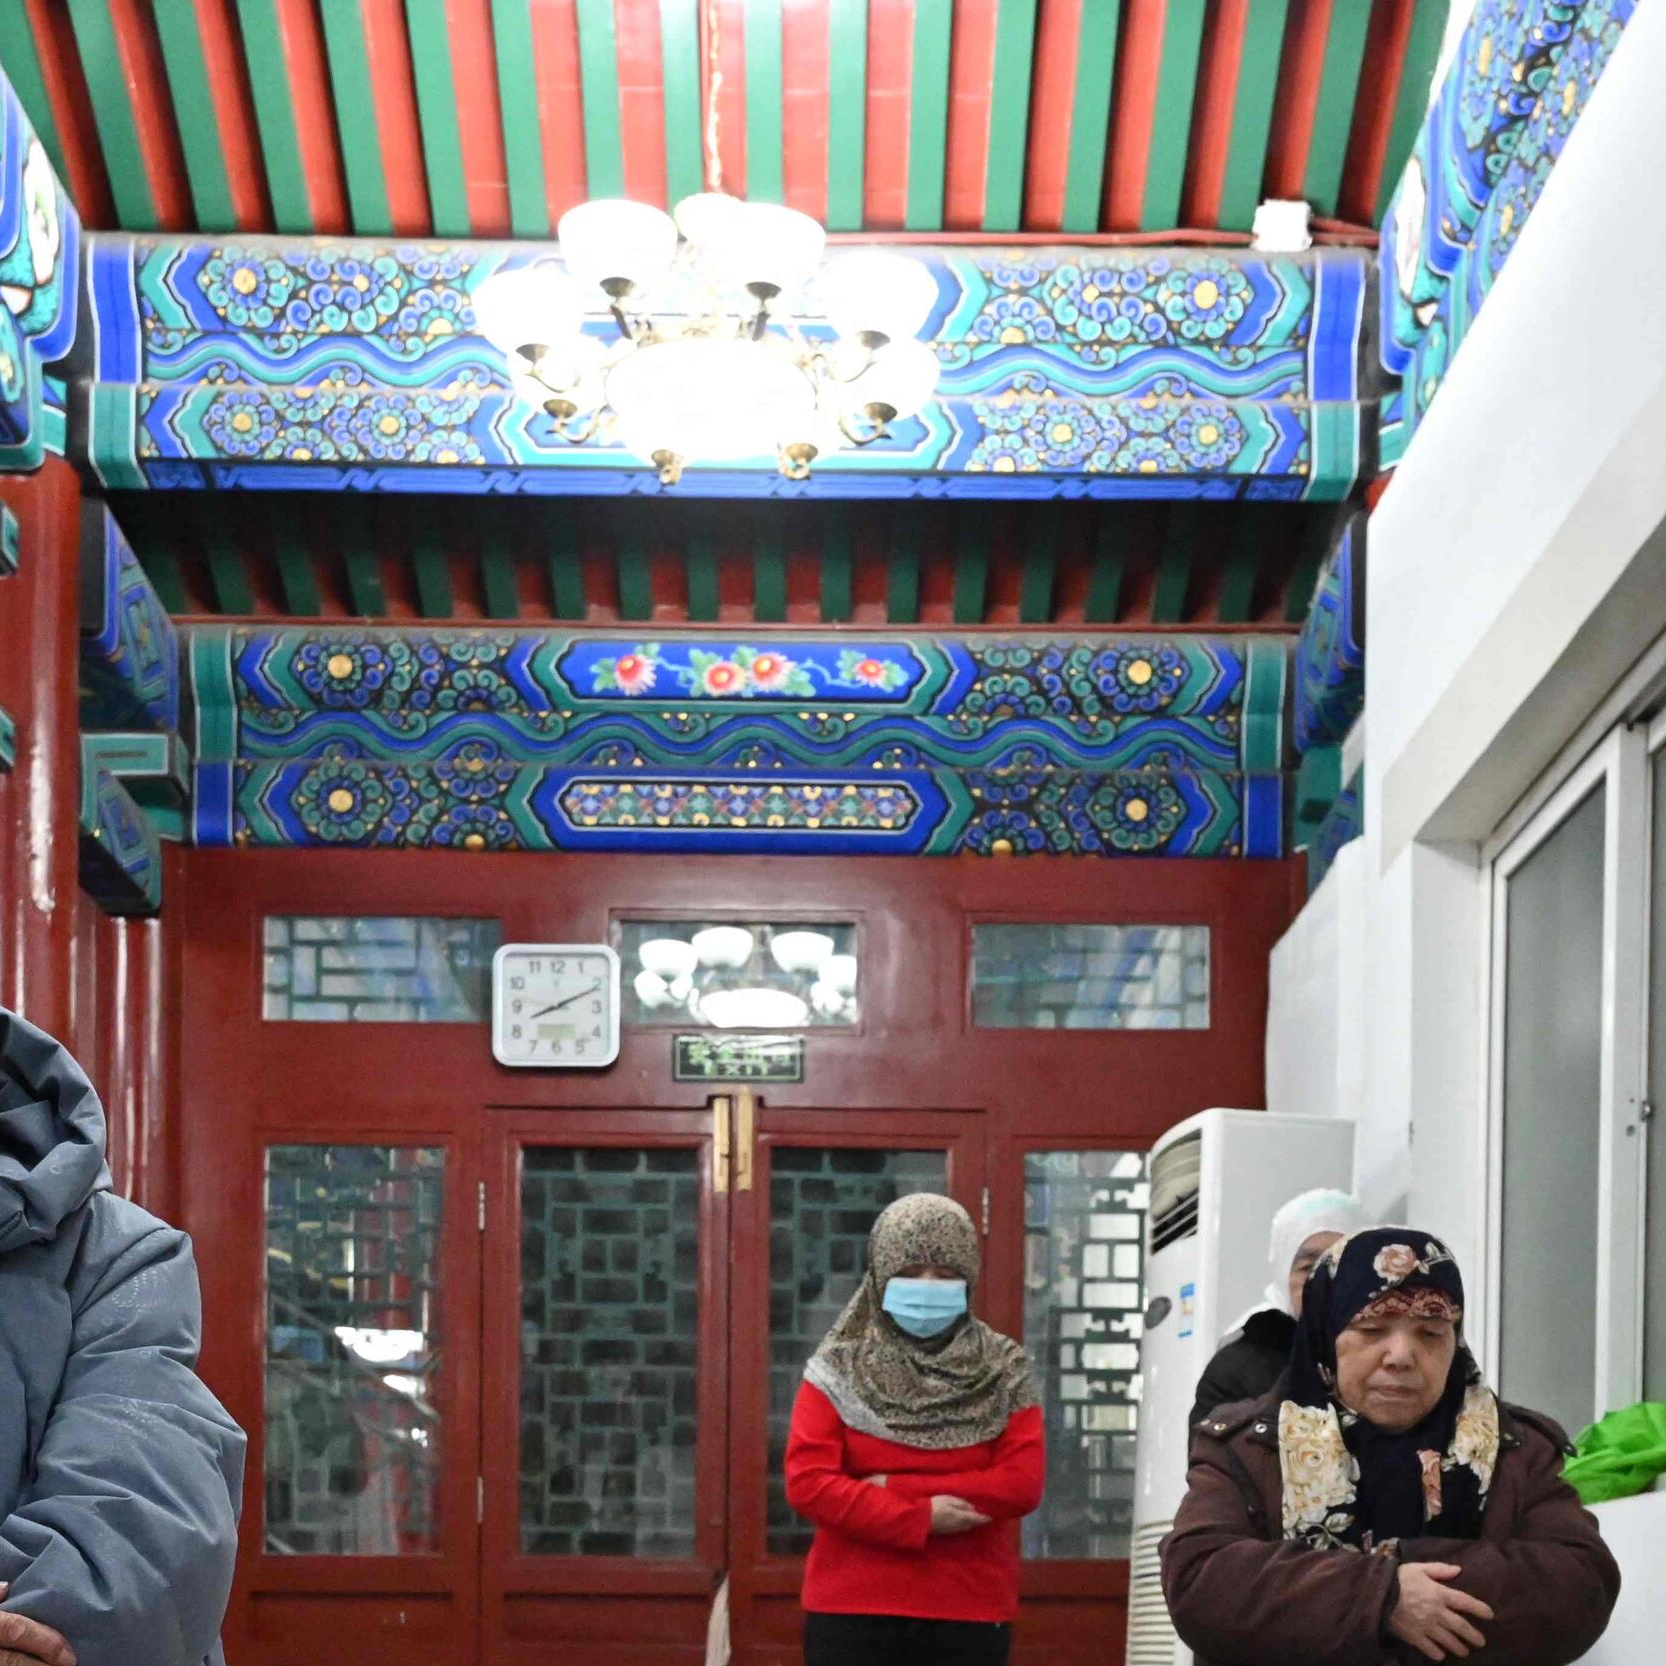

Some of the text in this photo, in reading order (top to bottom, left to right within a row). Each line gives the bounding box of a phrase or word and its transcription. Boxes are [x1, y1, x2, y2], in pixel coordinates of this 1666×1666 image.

[529, 960, 541, 974] 11
[551, 960, 566, 974] 12
[510, 976, 525, 990] 10
[512, 999, 522, 1014] 9
[592, 1000, 602, 1014] 3
[512, 1025, 522, 1039] 8
[592, 1025, 601, 1038] 4
[551, 1040, 561, 1055] 6
[575, 1040, 585, 1054] 5
